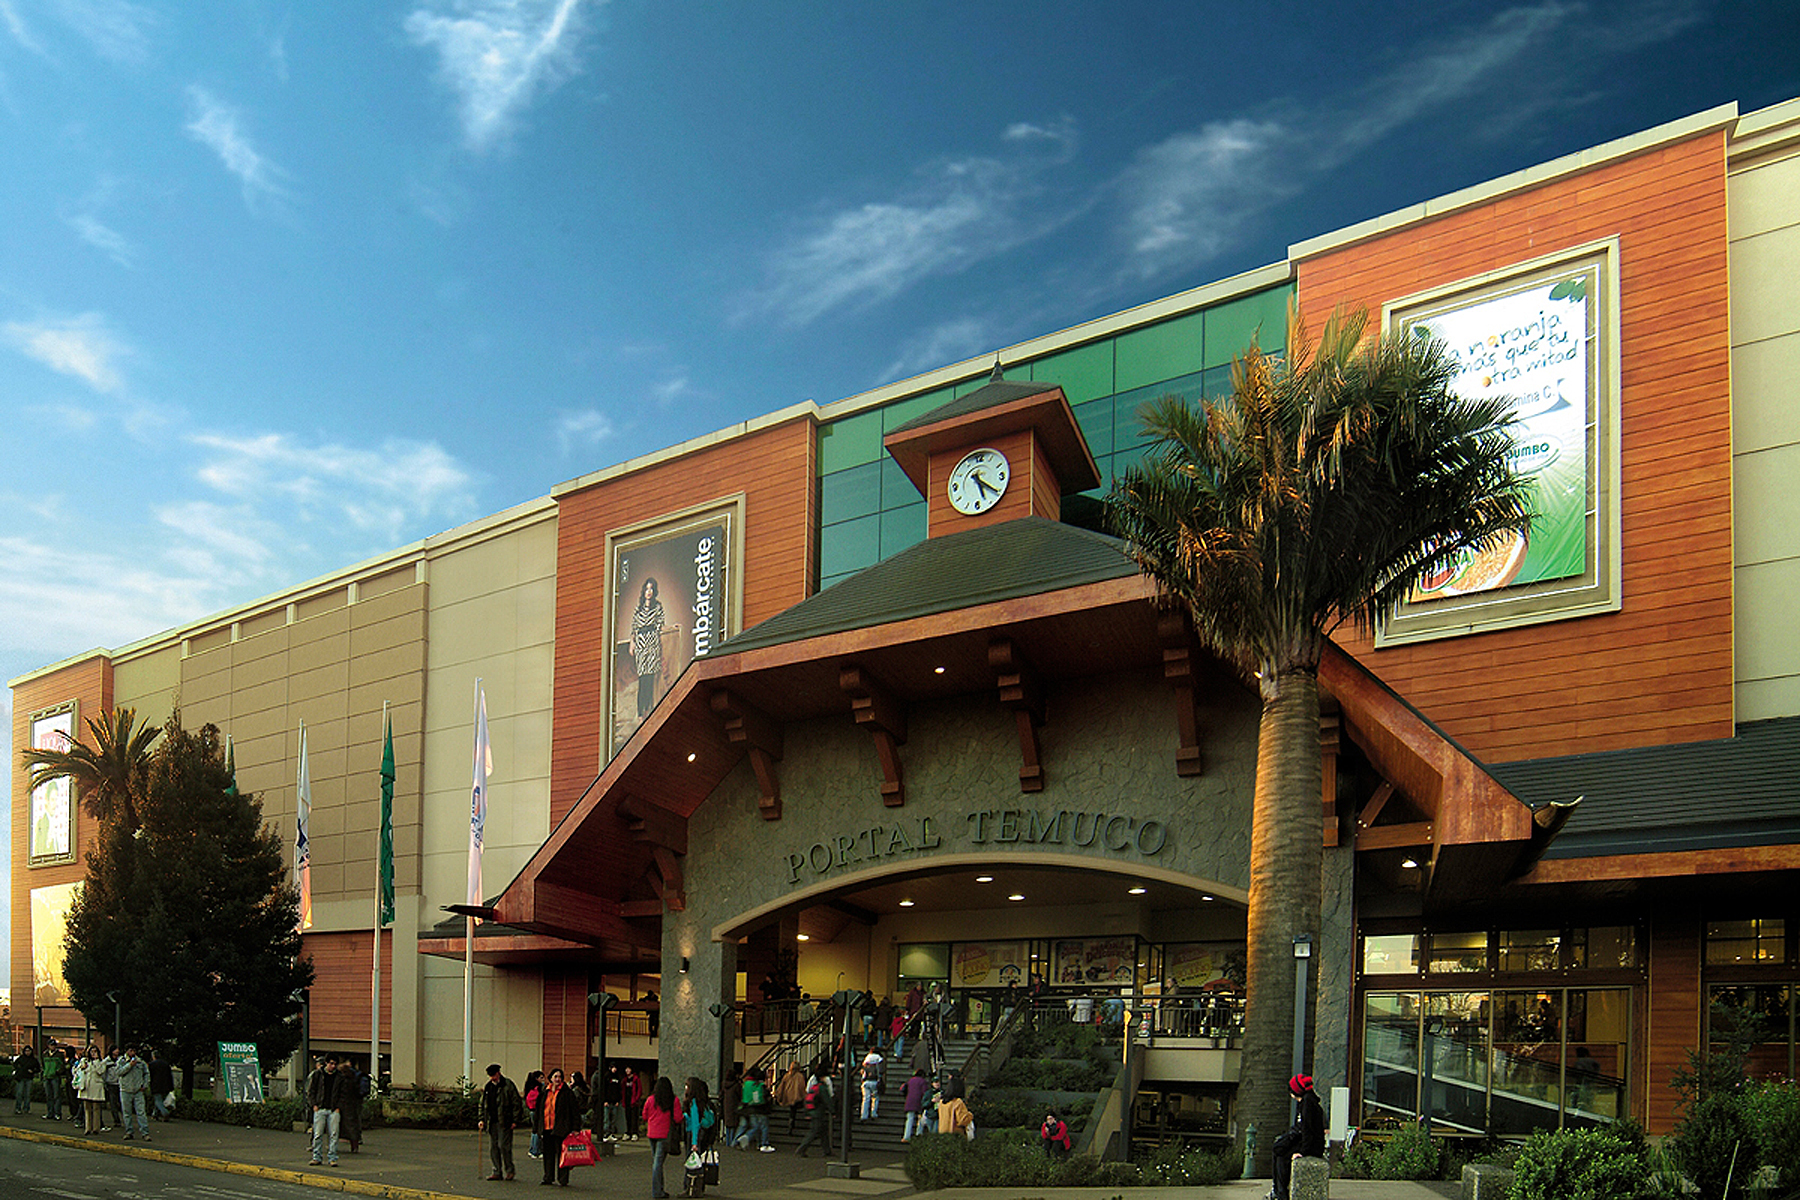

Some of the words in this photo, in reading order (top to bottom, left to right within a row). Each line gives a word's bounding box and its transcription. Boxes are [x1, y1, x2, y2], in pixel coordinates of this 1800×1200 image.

[1505, 338, 1540, 366] que
[1547, 329, 1570, 348] tu
[1526, 338, 1579, 373] mitad
[1507, 441, 1551, 460] JUMBO
[691, 536, 713, 659] mbárcate
[783, 816, 942, 885] PORTAL
[966, 808, 1170, 856] TEMUCO
[221, 1043, 256, 1053] JUMBO
